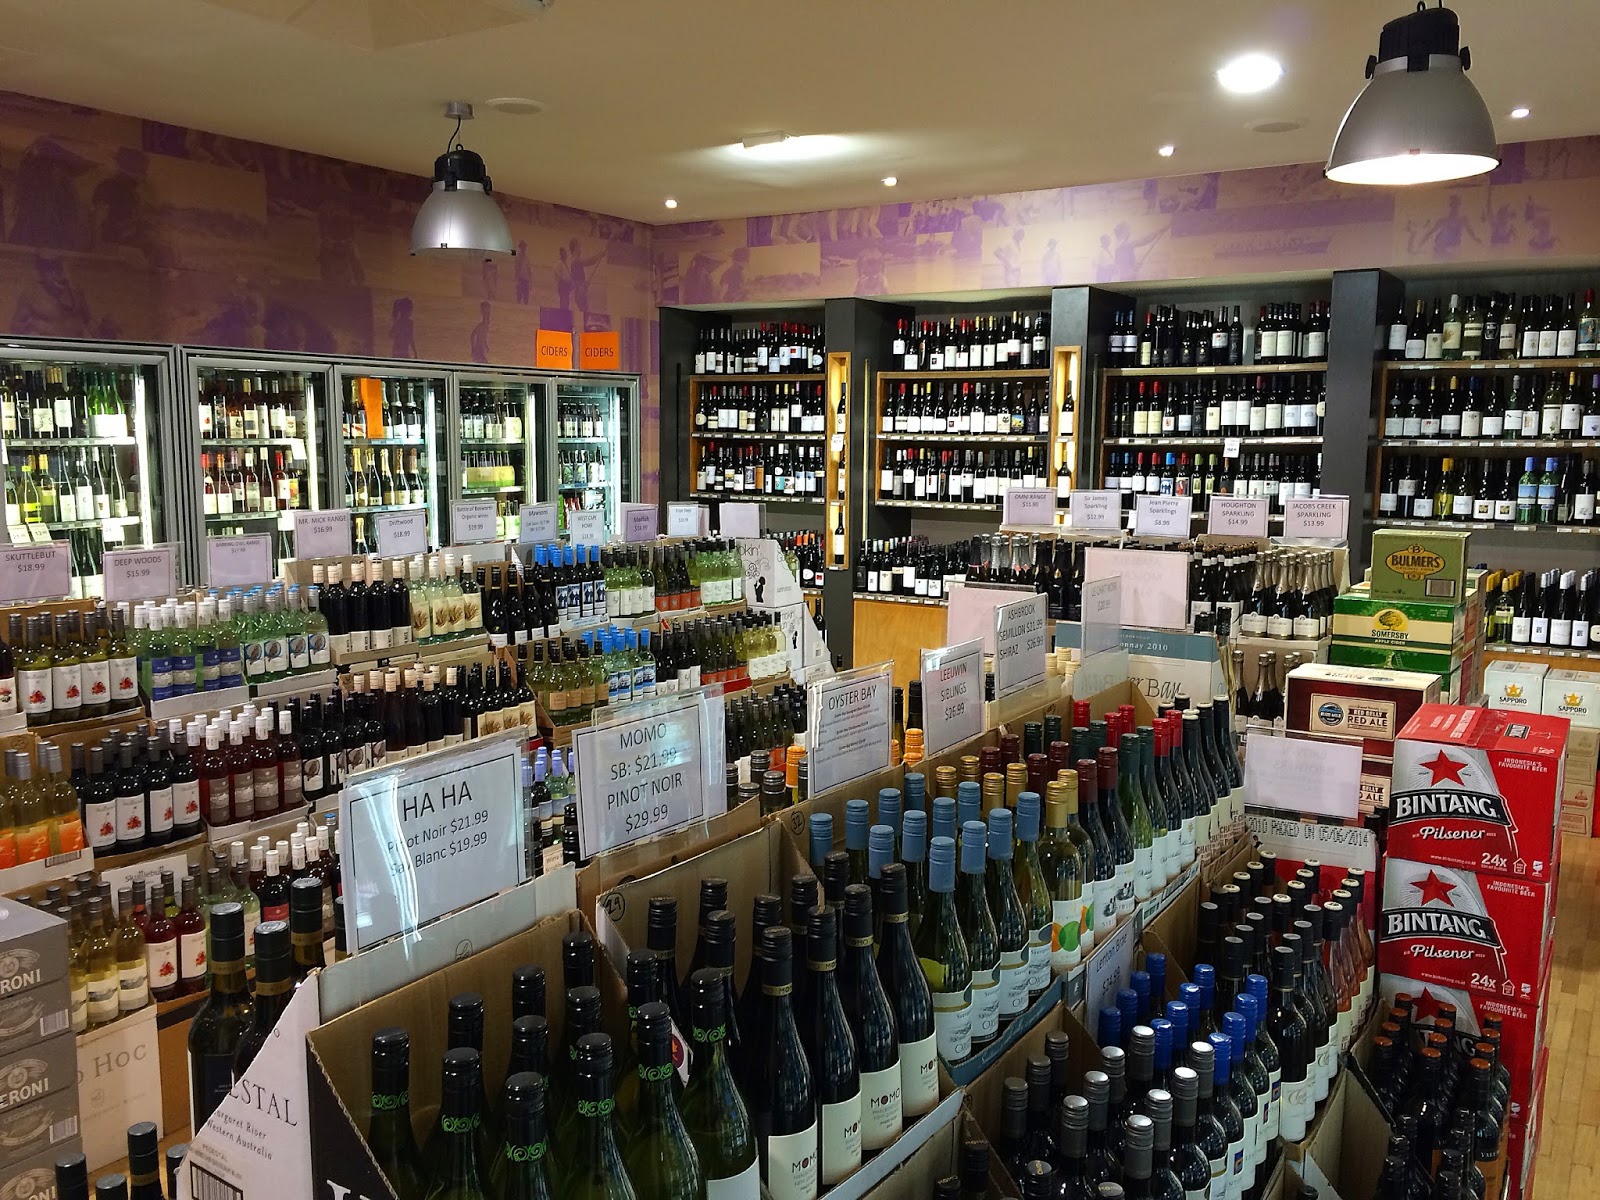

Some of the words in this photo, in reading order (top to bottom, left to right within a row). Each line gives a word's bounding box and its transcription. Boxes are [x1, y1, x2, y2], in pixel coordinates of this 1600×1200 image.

[541, 346, 568, 357] CIDERS
[585, 347, 614, 357] CIDERS
[1149, 507, 1177, 515] Sparklings
[298, 517, 310, 525] MR.
[311, 516, 326, 524] MICK
[327, 515, 347, 523] RANGE
[389, 518, 414, 527] Driftwood
[468, 523, 484, 531] $19.99
[1154, 519, 1171, 527] $8.99
[1228, 518, 1249, 526] $14.99
[313, 526, 333, 534] $16.99
[5, 550, 57, 562] SKUTTLEBUT
[736, 543, 761, 556] okin'
[17, 563, 46, 573] $18.99
[114, 558, 133, 567] DEEP
[134, 555, 162, 566] WOODS
[1391, 555, 1441, 569] BULMERS
[126, 569, 151, 578] $15.99
[1007, 603, 1036, 621] ASHBROOK
[999, 623, 1026, 642] SEMILLON
[1371, 629, 1409, 640] SOMERSBY
[1000, 644, 1019, 661] SHIRAZ
[1119, 641, 1144, 650] onnay
[1147, 642, 1168, 651] 2010
[940, 661, 967, 682] LEEUWIN
[828, 689, 859, 710] OYSTER
[861, 685, 877, 701] BAY
[940, 682, 967, 702] SIBLINGS
[1499, 696, 1528, 705] SAPPORO
[1365, 710, 1383, 718] BELLY
[1558, 705, 1587, 714] SAPPORO
[1348, 715, 1367, 725] RED
[1369, 717, 1388, 727] ALE
[620, 722, 667, 749] MOMO
[611, 761, 632, 781] SB:
[635, 747, 677, 776] $21.99
[1498, 762, 1531, 772] FAVOURITE
[1532, 765, 1548, 773] BEER
[1504, 757, 1543, 767] INDONESIA'S
[607, 782, 648, 811] PINOT
[651, 772, 683, 796] NOIR
[1361, 785, 1380, 793] BELLY
[403, 792, 435, 822] HA
[441, 780, 473, 810] HA
[1365, 792, 1384, 802] ALE
[1396, 794, 1498, 818] BINTANG
[625, 804, 669, 835] $29.99
[387, 832, 419, 853] Piot
[422, 824, 448, 844] Noir
[450, 809, 489, 836] $21.99
[1271, 820, 1299, 838] PACKED
[1304, 825, 1315, 840] ON
[1419, 826, 1486, 840] Pilsener
[415, 846, 447, 869] Blanc
[449, 831, 488, 857] $19.99
[1481, 852, 1508, 868] 24x
[1487, 884, 1519, 895] FAVOURITE
[1520, 889, 1536, 898] BEER
[1492, 880, 1530, 891] INDONESIA'S
[1388, 912, 1488, 939] BINTANG
[1410, 944, 1475, 959] Pilsener
[1096, 947, 1116, 973] Lenton
[1470, 972, 1497, 988] 24x
[1485, 1000, 1523, 1013] INDONESIA'S
[1512, 1010, 1528, 1019] BEER
[0, 1077, 49, 1109] ERONI
[870, 1087, 901, 1109] MOMO
[213, 1110, 245, 1130] argaret
[246, 1121, 268, 1140] River
[207, 1119, 234, 1141] Western
[235, 1135, 273, 1161] Australia
[791, 1152, 817, 1174] MOM
